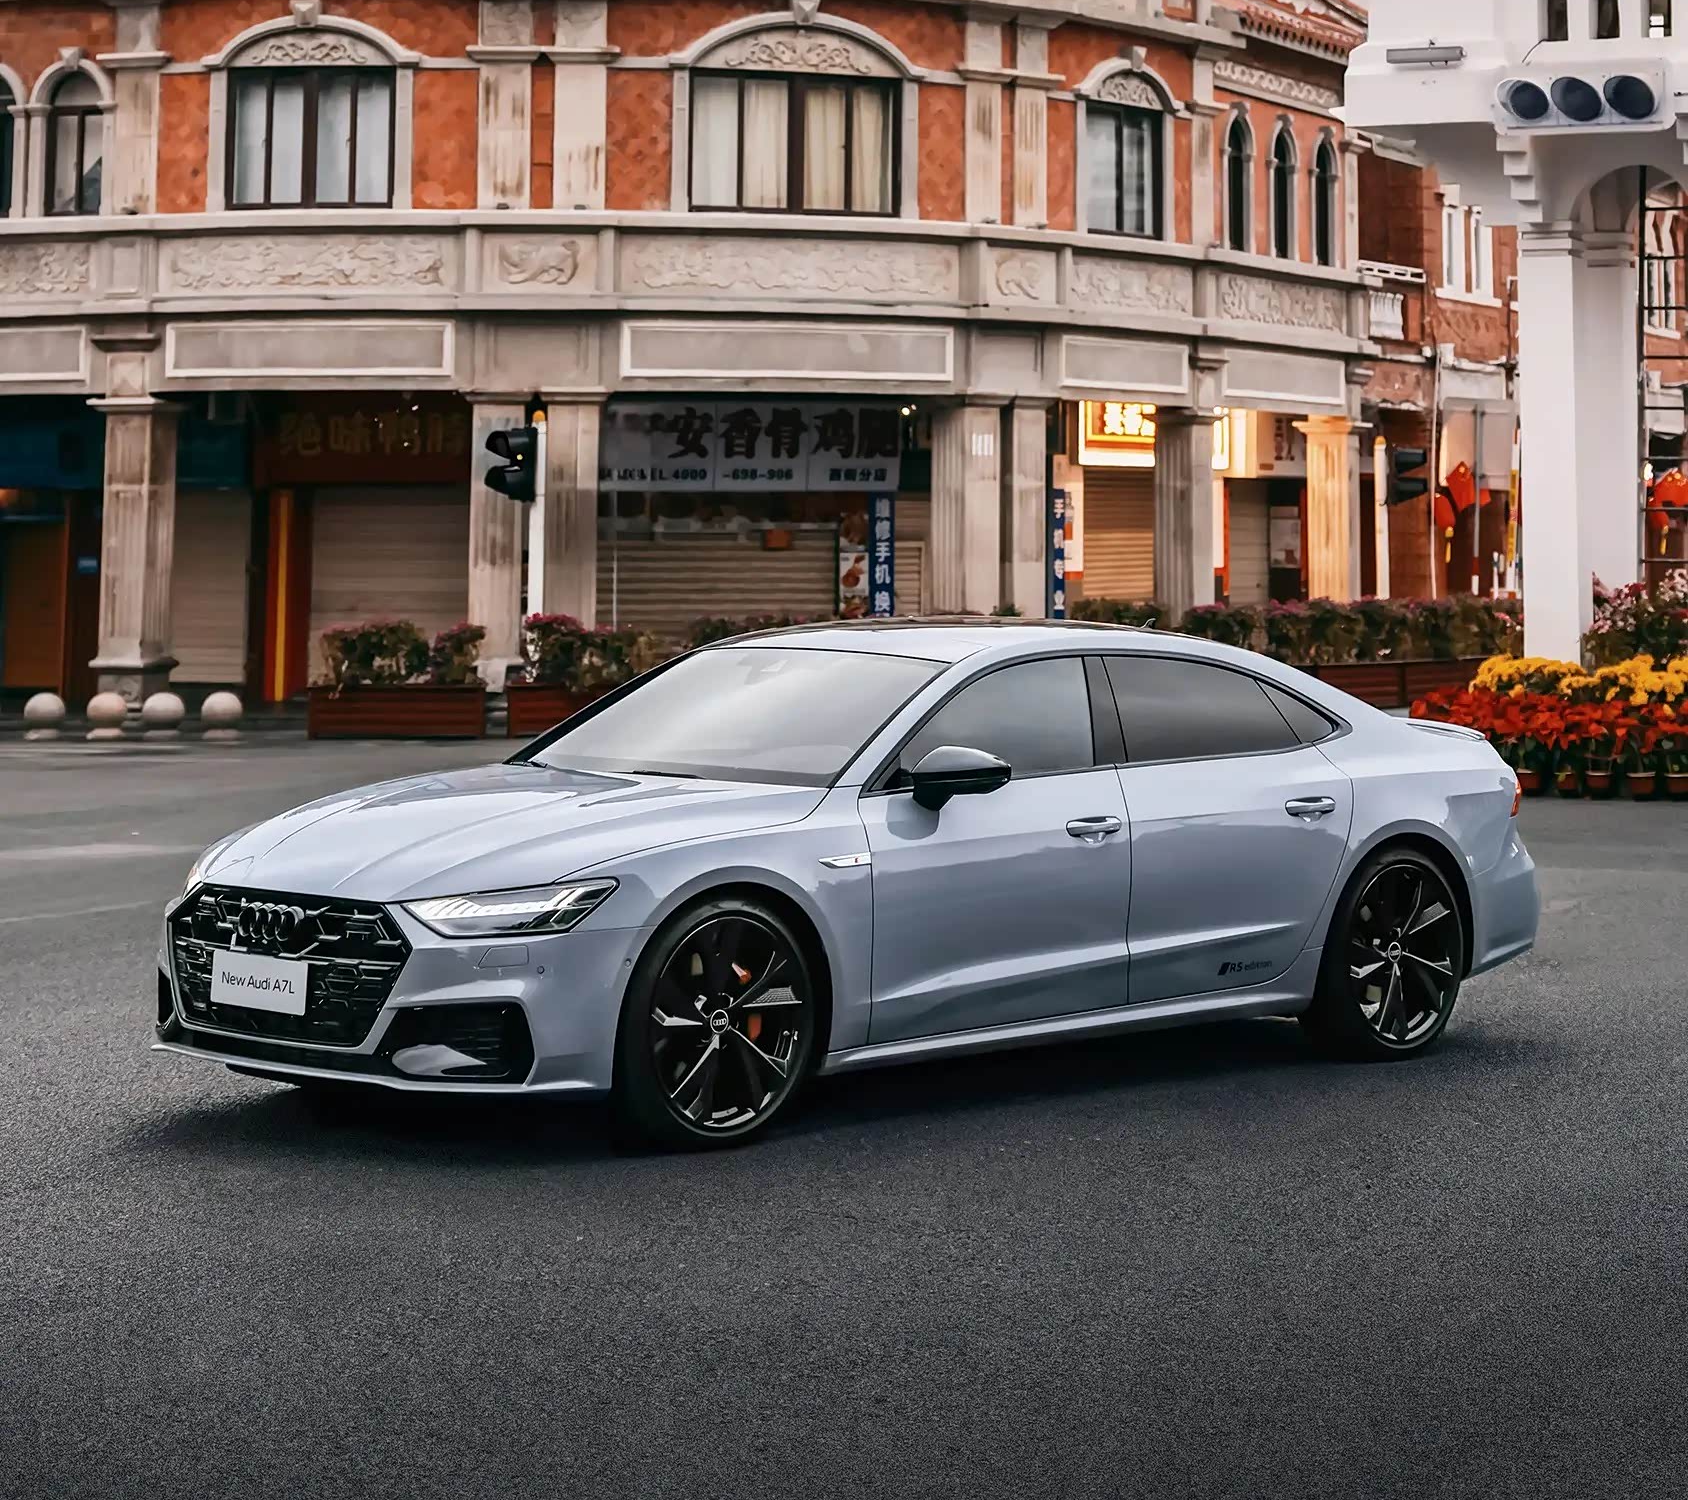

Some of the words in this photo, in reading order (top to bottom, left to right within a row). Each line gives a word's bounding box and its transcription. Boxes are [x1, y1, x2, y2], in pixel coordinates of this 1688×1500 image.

[1229, 961, 1243, 974] RS
[221, 971, 246, 986] New
[247, 975, 271, 990] Audi
[272, 978, 295, 994] A7L
